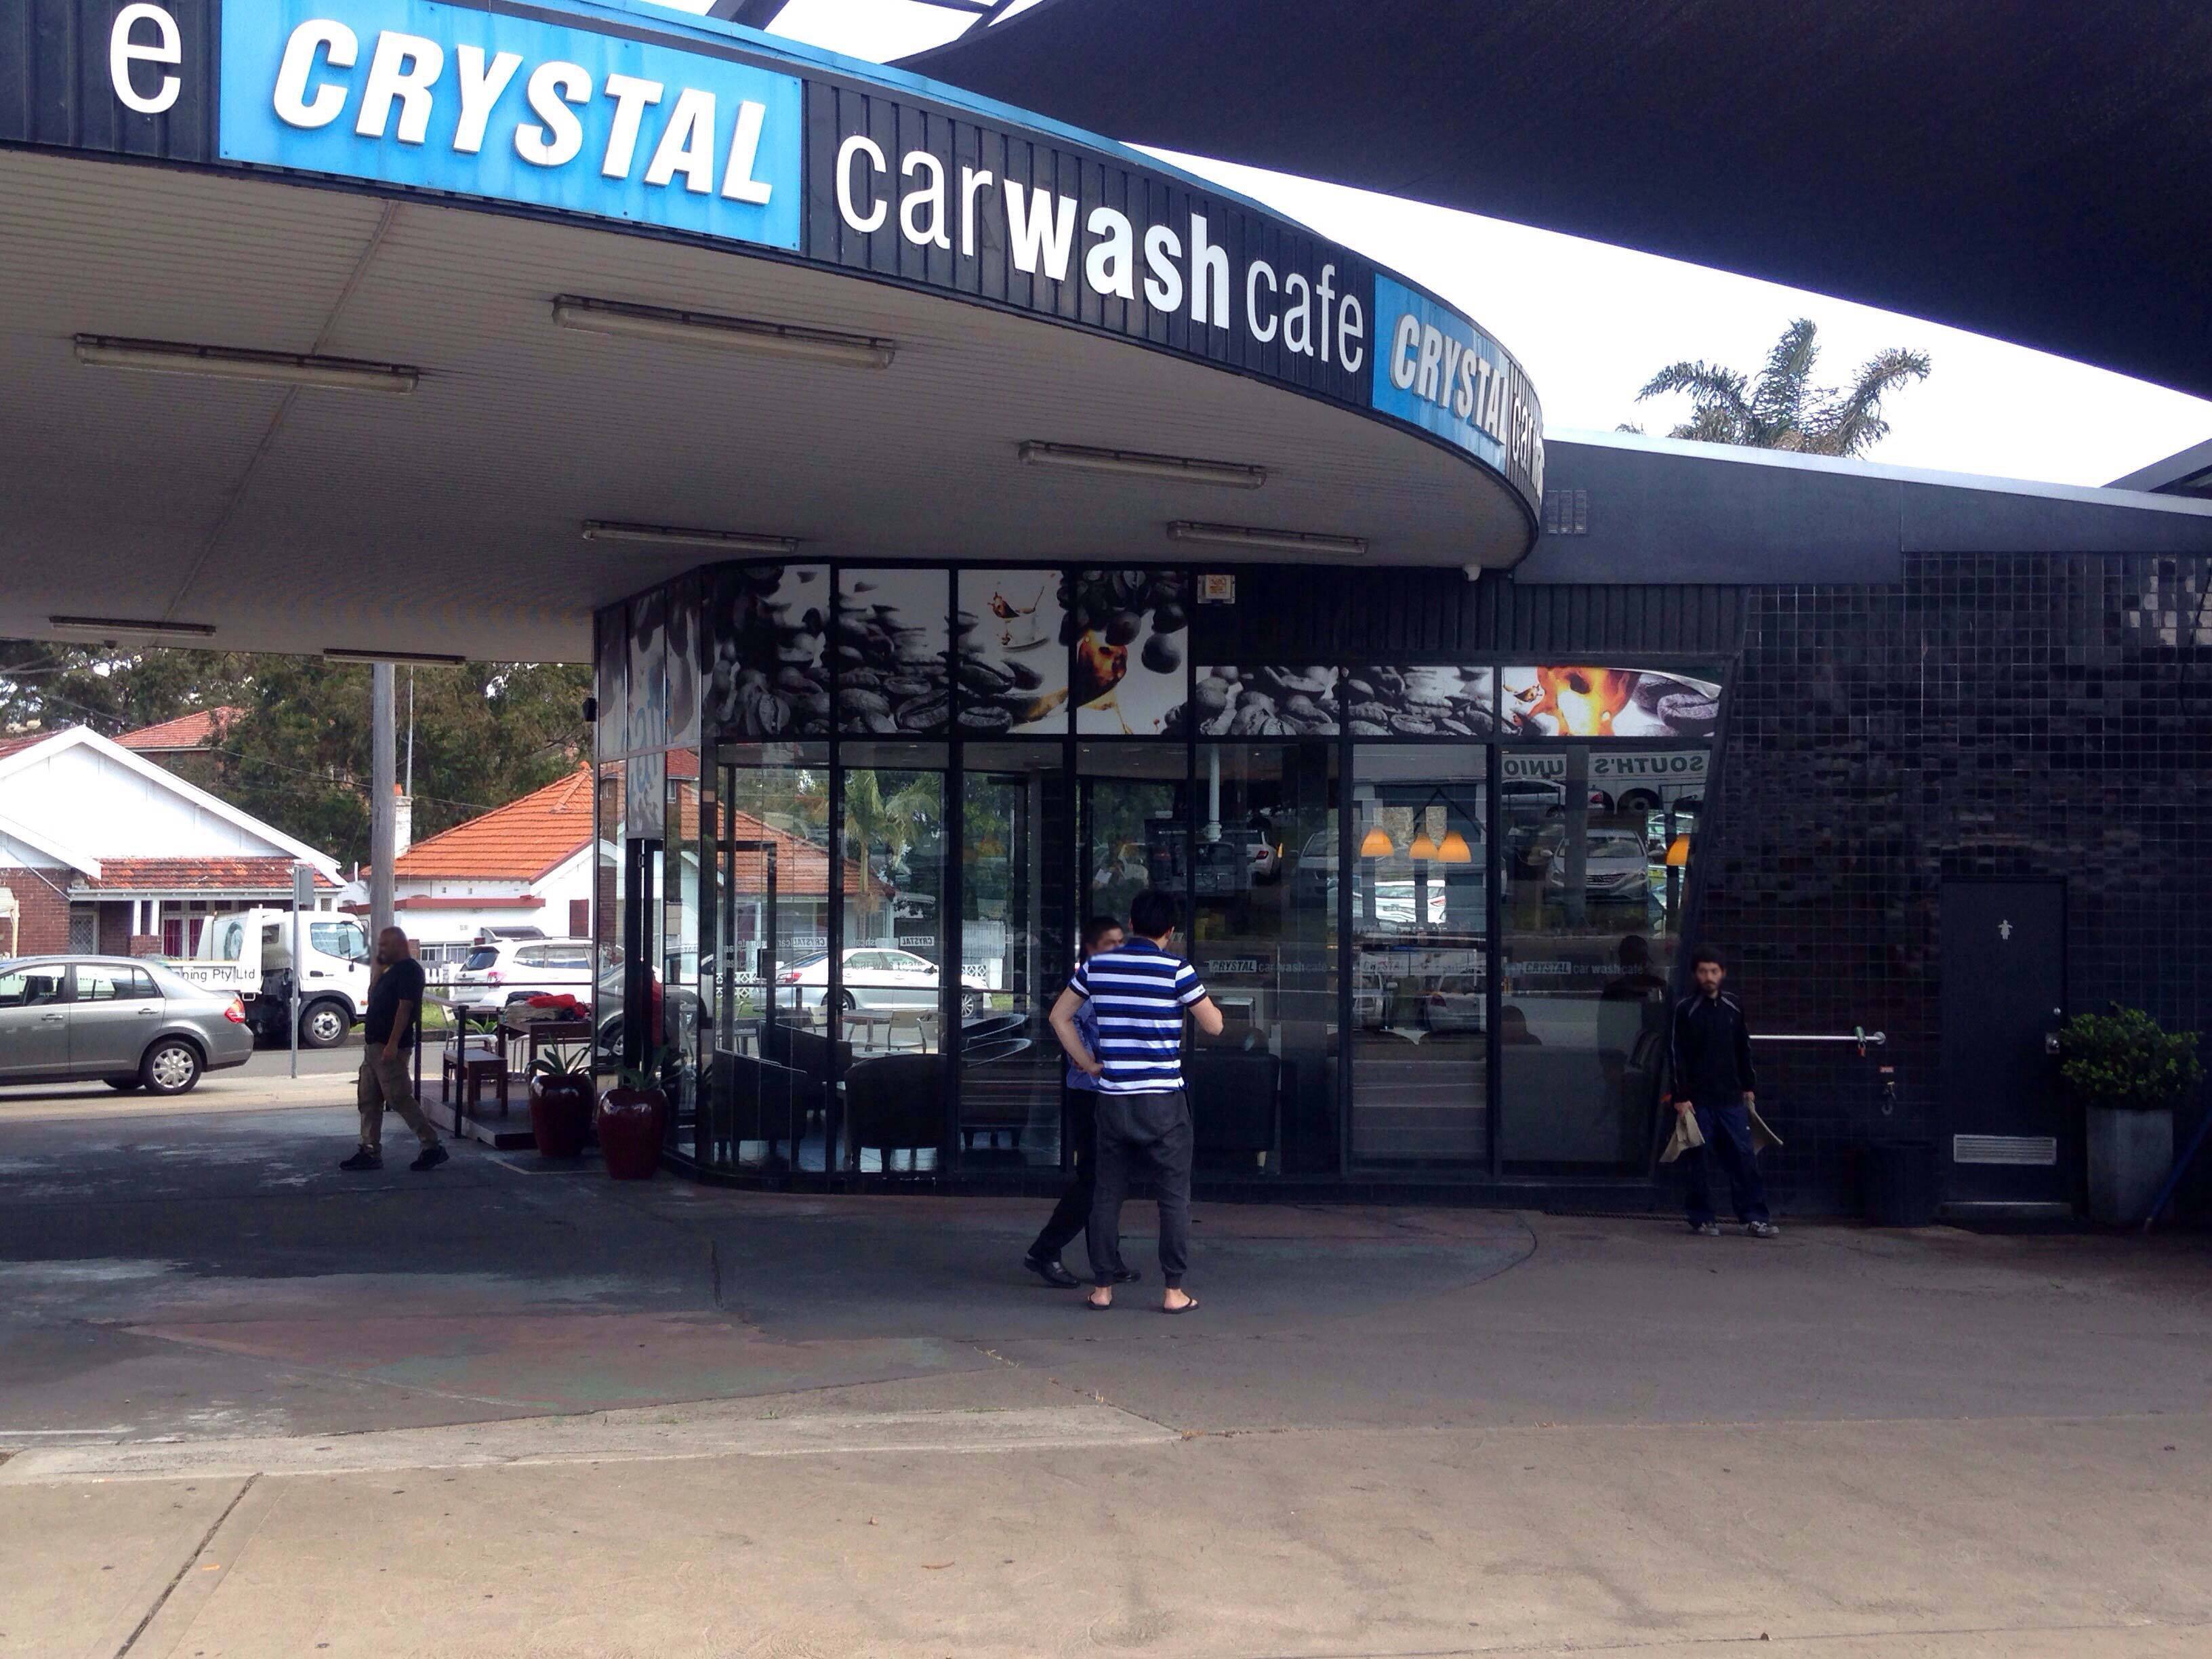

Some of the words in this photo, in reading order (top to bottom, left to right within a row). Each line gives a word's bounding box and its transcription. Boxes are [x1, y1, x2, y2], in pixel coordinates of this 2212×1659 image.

[110, 3, 182, 114] e
[273, 18, 773, 205] CRYSTAL
[1246, 263, 1364, 373] cafe
[1391, 314, 1509, 445] CRYSTAL
[212, 968, 232, 982] Pty
[237, 968, 255, 979] Ltd
[1212, 960, 1255, 972] CRYSTAL
[1525, 962, 1569, 973] CRYSTAL
